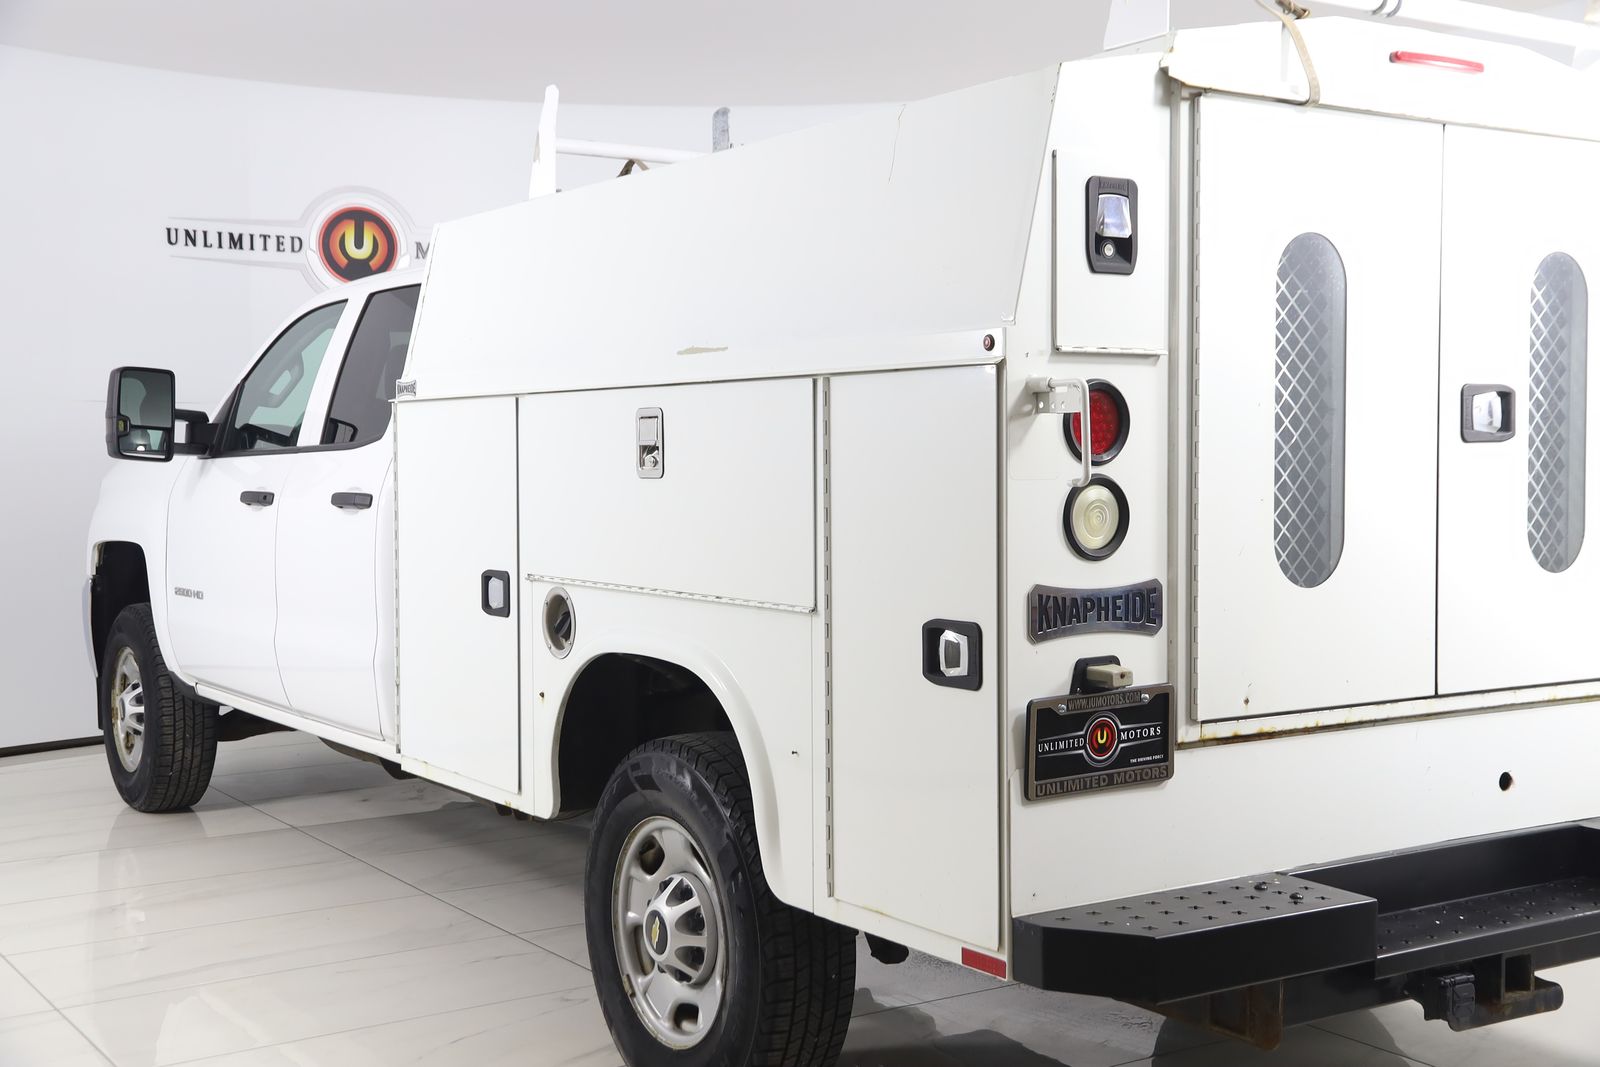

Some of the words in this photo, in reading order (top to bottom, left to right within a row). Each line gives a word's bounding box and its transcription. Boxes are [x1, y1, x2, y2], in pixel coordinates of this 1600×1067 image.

[166, 227, 303, 253] UNLIMITED
[1037, 587, 1157, 634] KNAPHEIDE
[1038, 737, 1085, 753] UNLIMITED
[1120, 726, 1161, 741] MOTORS
[1037, 774, 1109, 796] UNLIMITED
[1113, 765, 1168, 785] MOTORS
